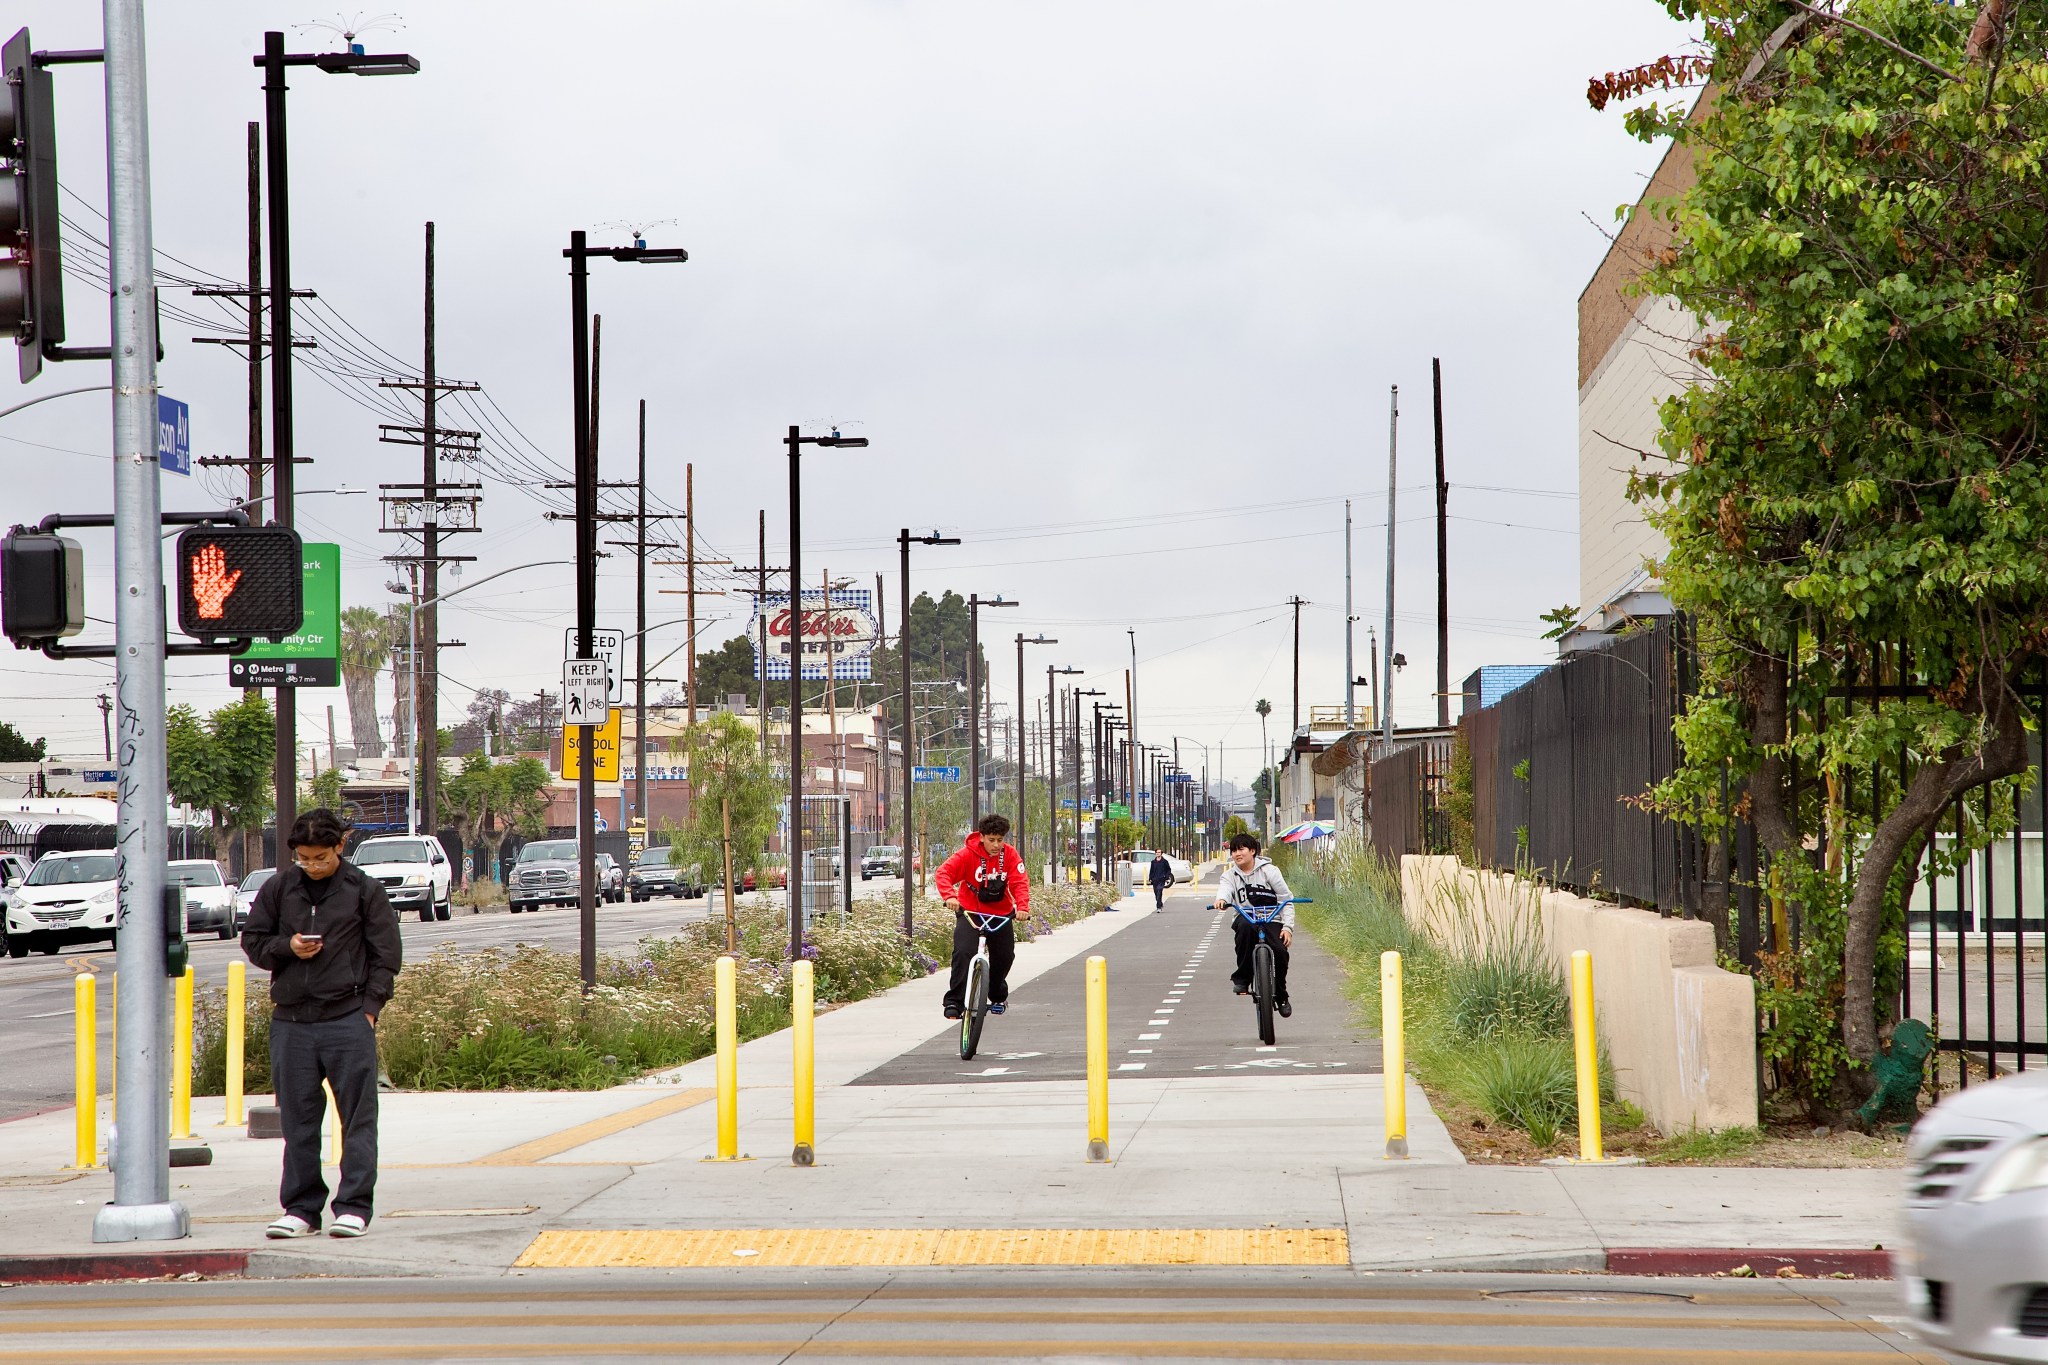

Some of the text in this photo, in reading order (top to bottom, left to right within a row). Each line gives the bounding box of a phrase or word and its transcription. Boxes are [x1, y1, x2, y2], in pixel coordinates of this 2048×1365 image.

[159, 421, 176, 455] uson
[185, 451, 190, 471] E
[303, 560, 321, 569] ark
[251, 634, 324, 645] omunity Ctr
[573, 635, 616, 647] SEED
[780, 641, 845, 654] BEAD
[260, 665, 284, 673] Metro
[571, 664, 598, 676] KEEP
[567, 678, 604, 687] LEFT RIGHT
[568, 738, 614, 750] SCOOL
[575, 756, 606, 768] ZNE
[947, 767, 956, 777] St
